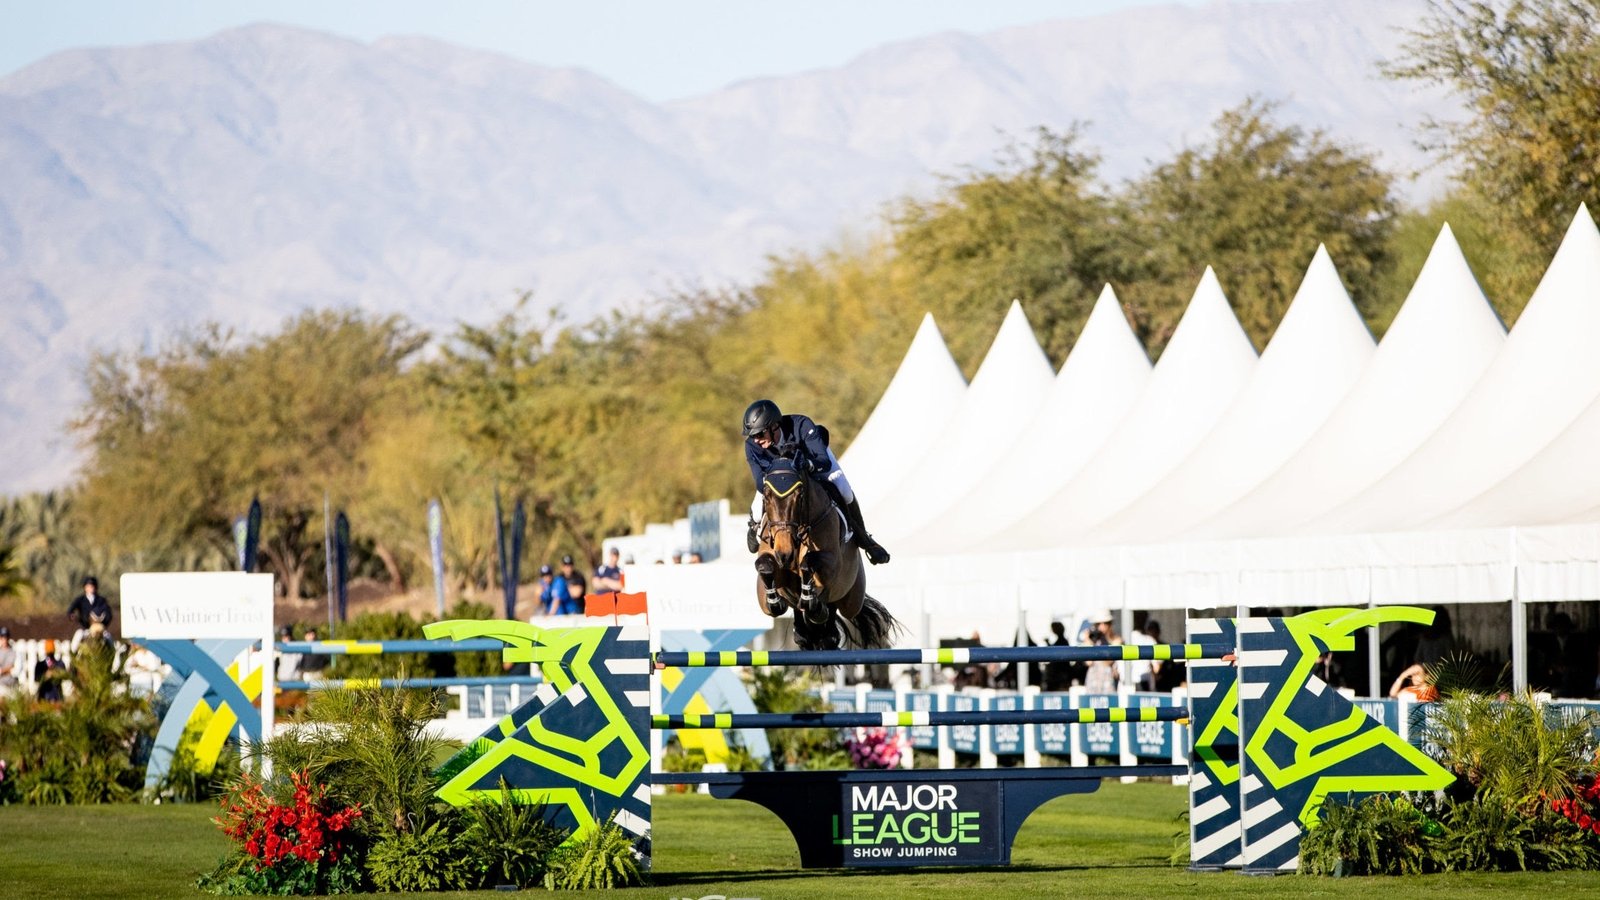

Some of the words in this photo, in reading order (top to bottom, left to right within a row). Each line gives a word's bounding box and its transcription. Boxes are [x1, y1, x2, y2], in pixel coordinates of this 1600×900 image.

[155, 607, 222, 625] Whittier
[852, 785, 957, 811] MAJOR
[832, 812, 980, 844] LEAGUE
[853, 848, 893, 858] SHOW
[897, 846, 958, 857] JUMPING
